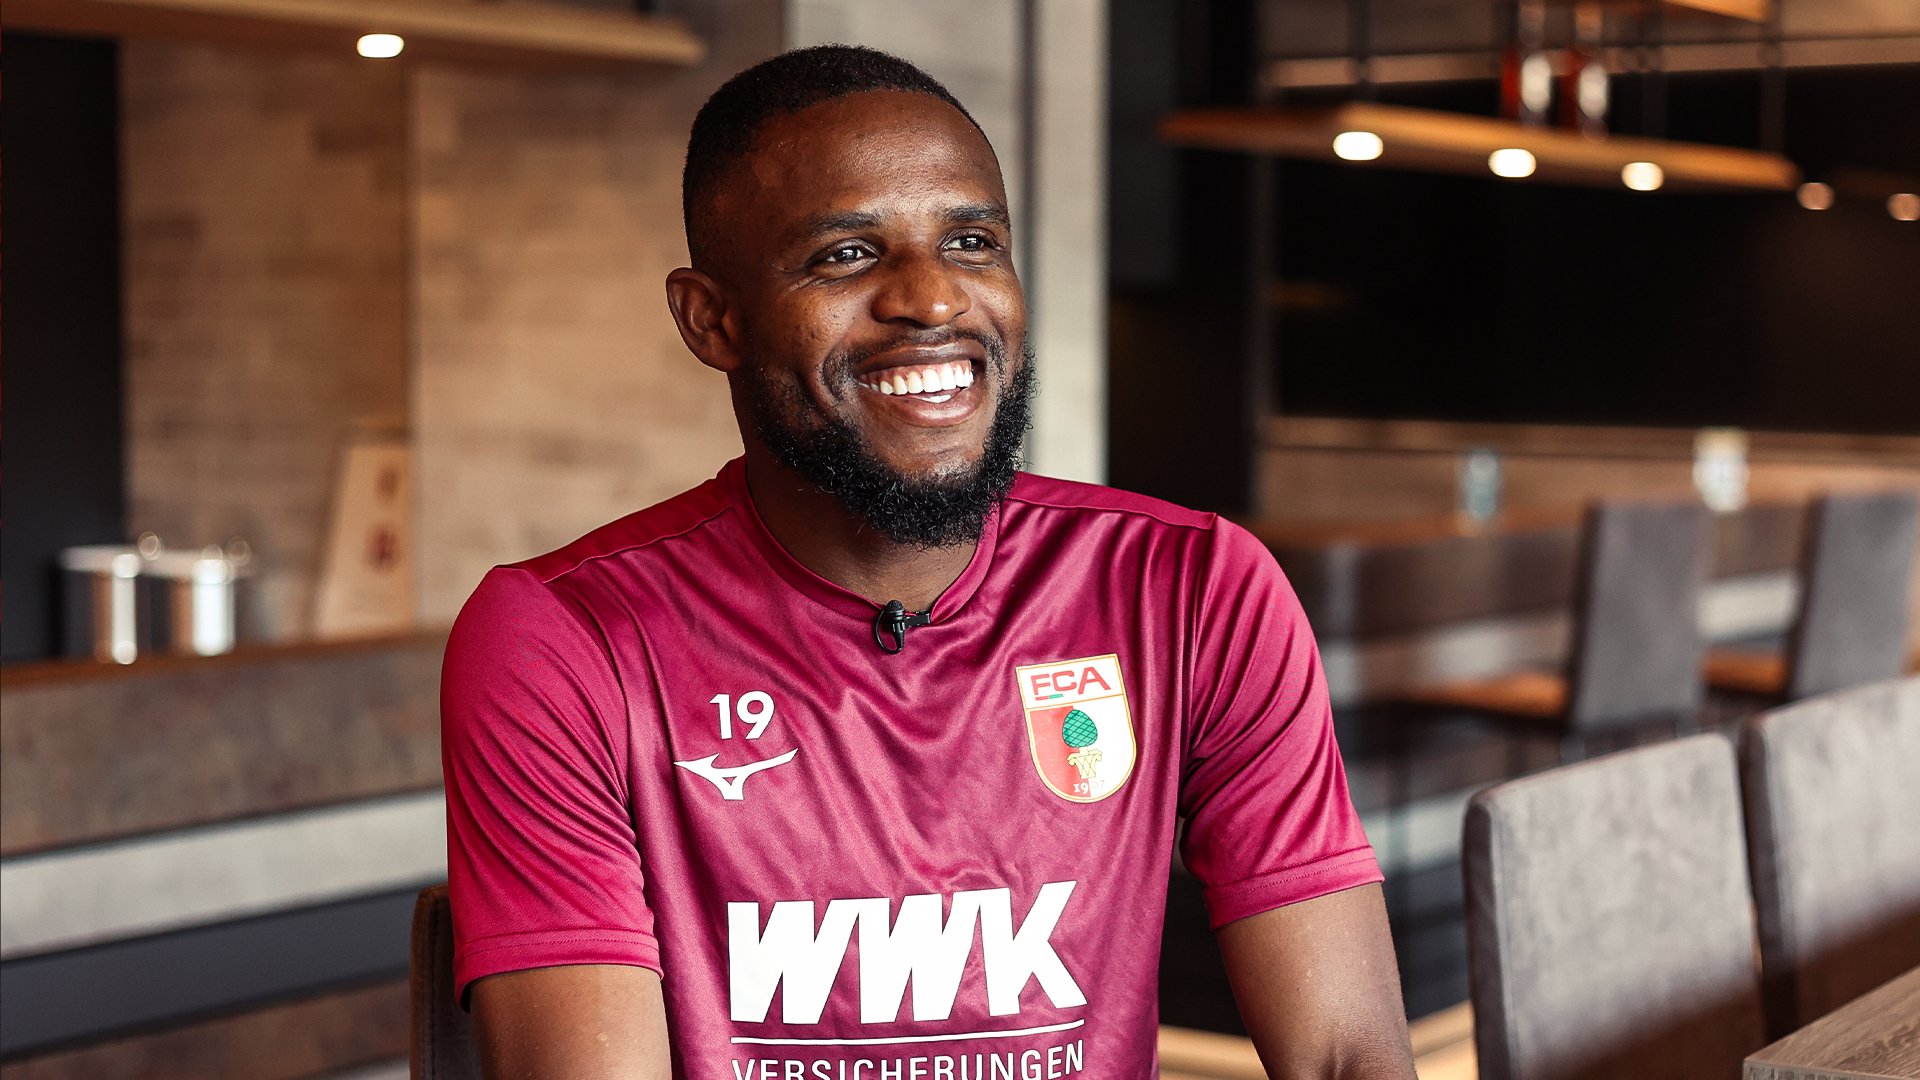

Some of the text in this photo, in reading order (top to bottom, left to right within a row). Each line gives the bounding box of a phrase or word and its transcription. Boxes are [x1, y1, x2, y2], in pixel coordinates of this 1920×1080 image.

[1030, 666, 1111, 695] FCA
[709, 690, 775, 741] 19
[727, 880, 1088, 1025] WWK
[730, 1039, 1084, 1080] VERSICHERUNGEN
